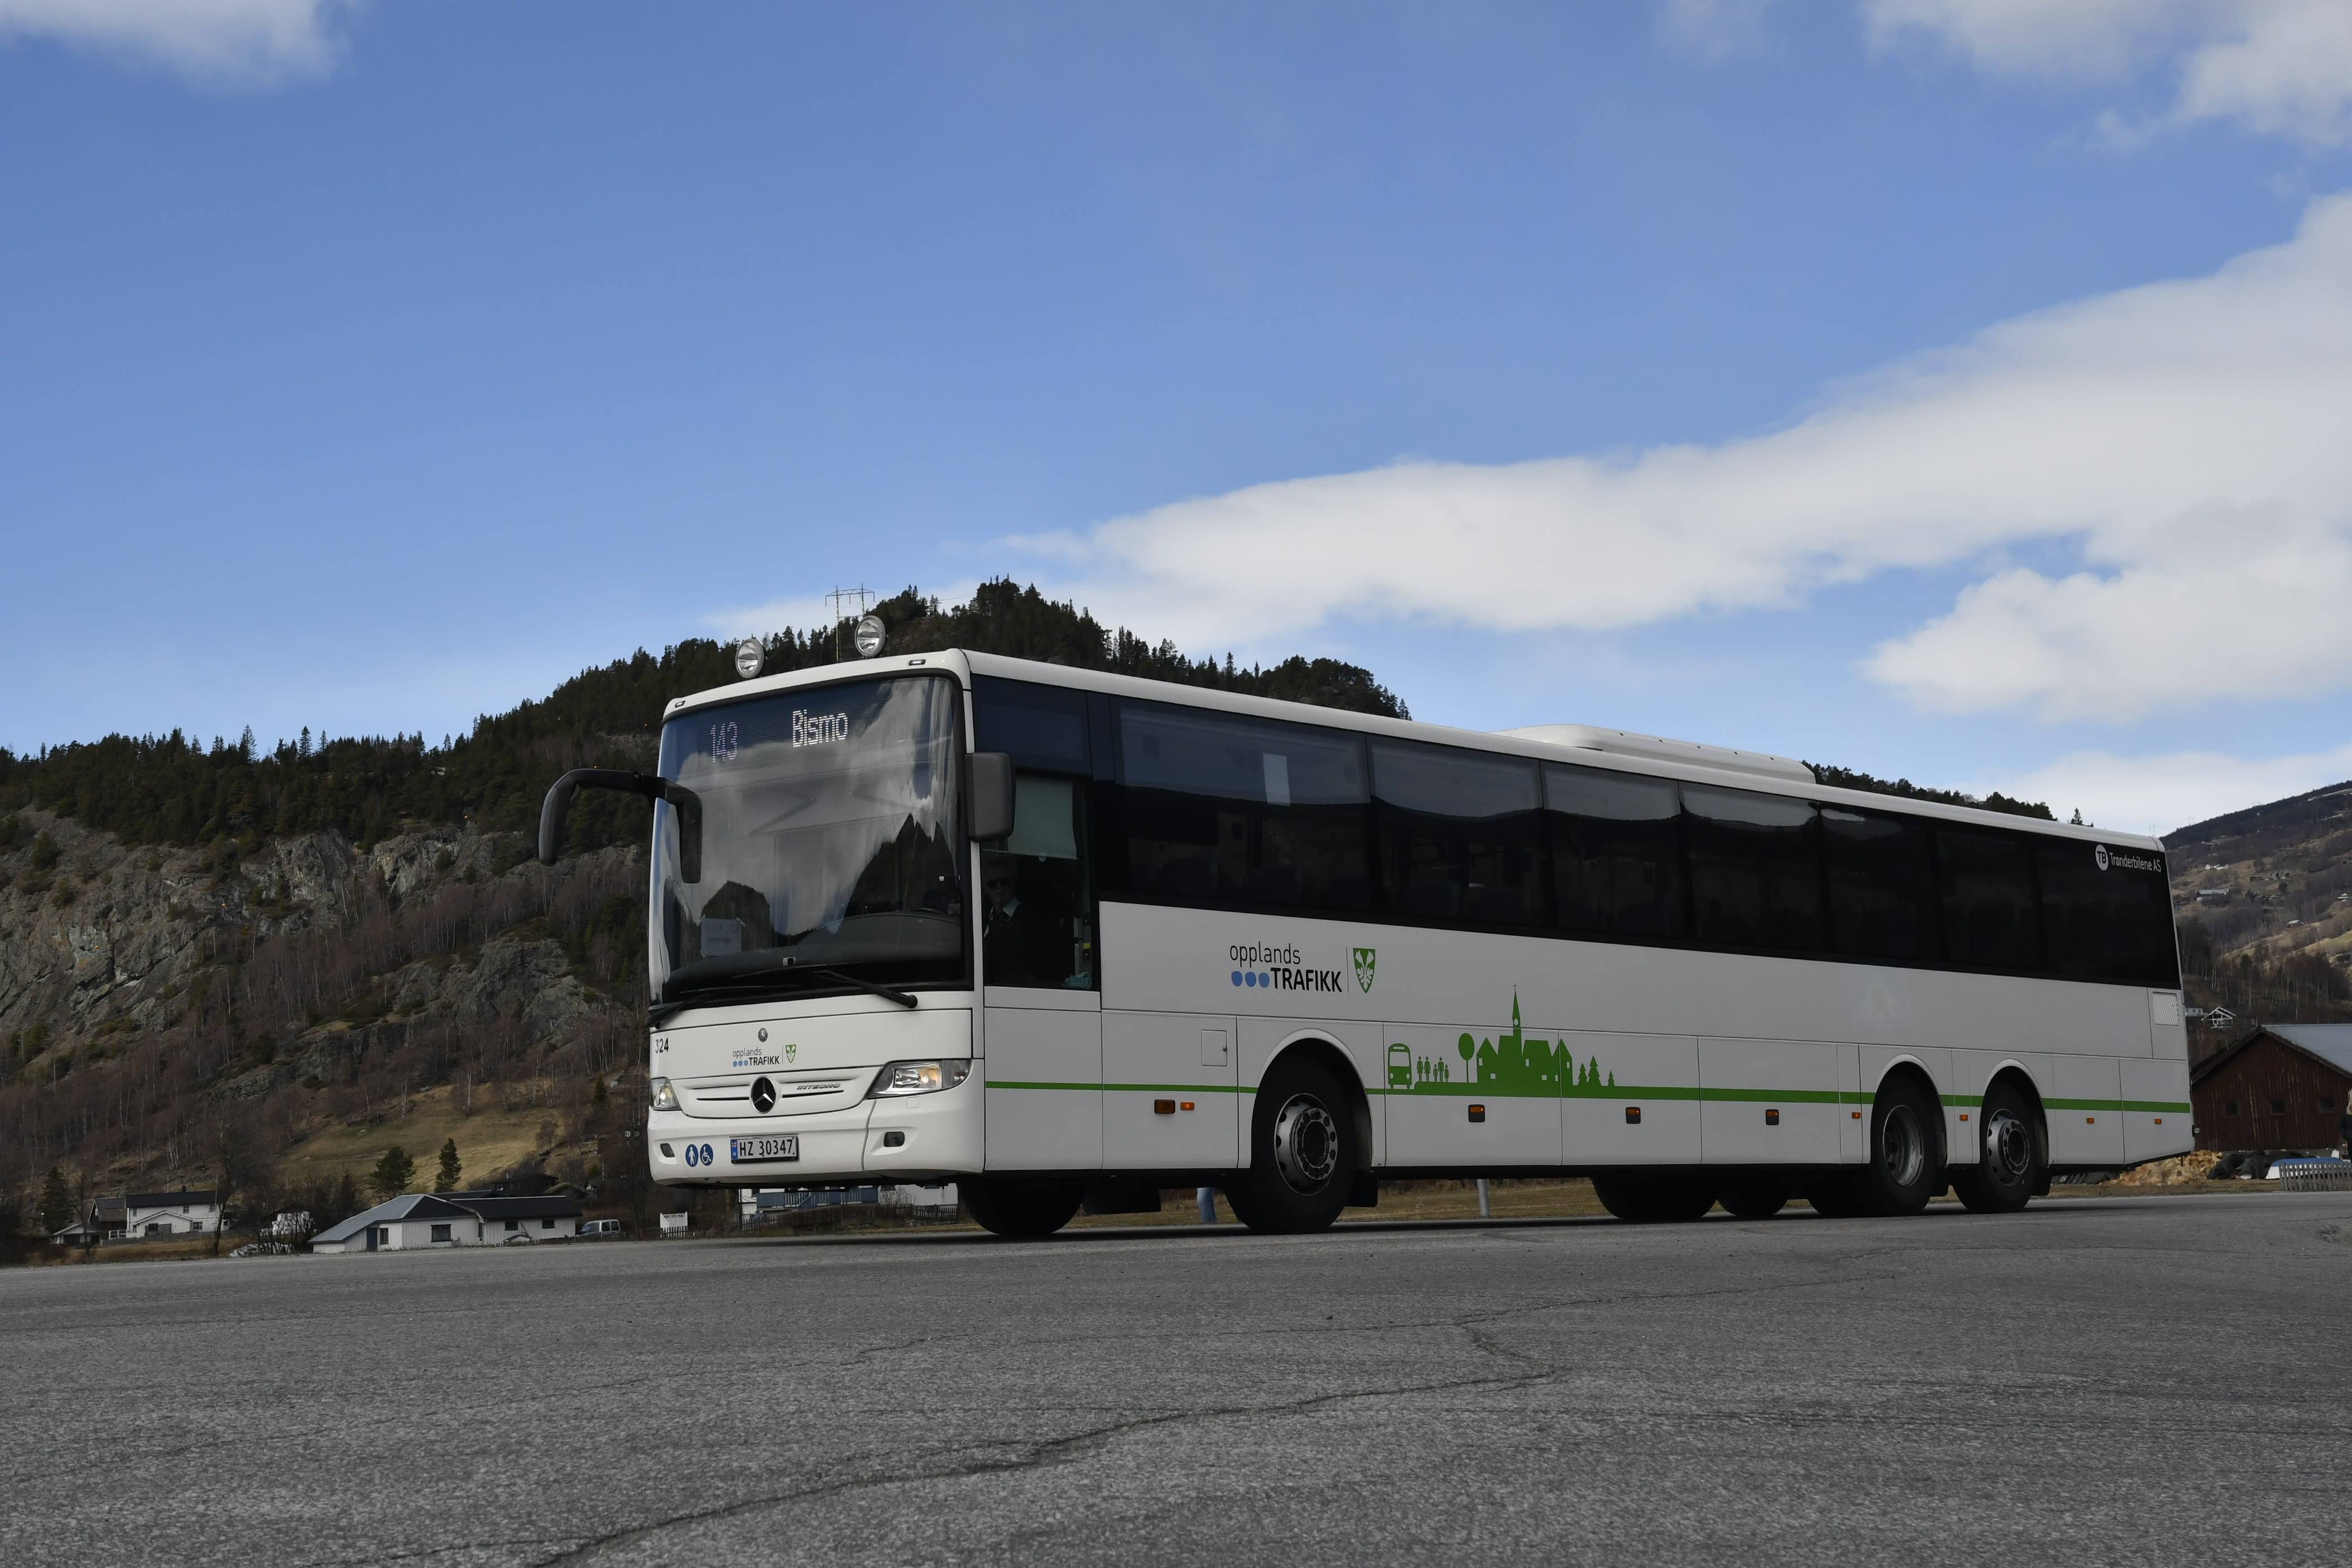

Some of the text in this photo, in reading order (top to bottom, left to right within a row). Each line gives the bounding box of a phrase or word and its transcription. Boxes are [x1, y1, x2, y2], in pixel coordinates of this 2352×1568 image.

[792, 709, 848, 748] Bismo
[710, 721, 738, 763] 143
[2097, 850, 2106, 864] TB
[2153, 858, 2162, 872] AS
[1230, 941, 1300, 968] opplands
[1270, 967, 1343, 993] TRAFIKK
[655, 1037, 669, 1054] 324
[732, 1046, 762, 1059] opplands
[749, 1055, 780, 1066] TRAFIKK
[740, 1139, 793, 1156] HZ 30347
